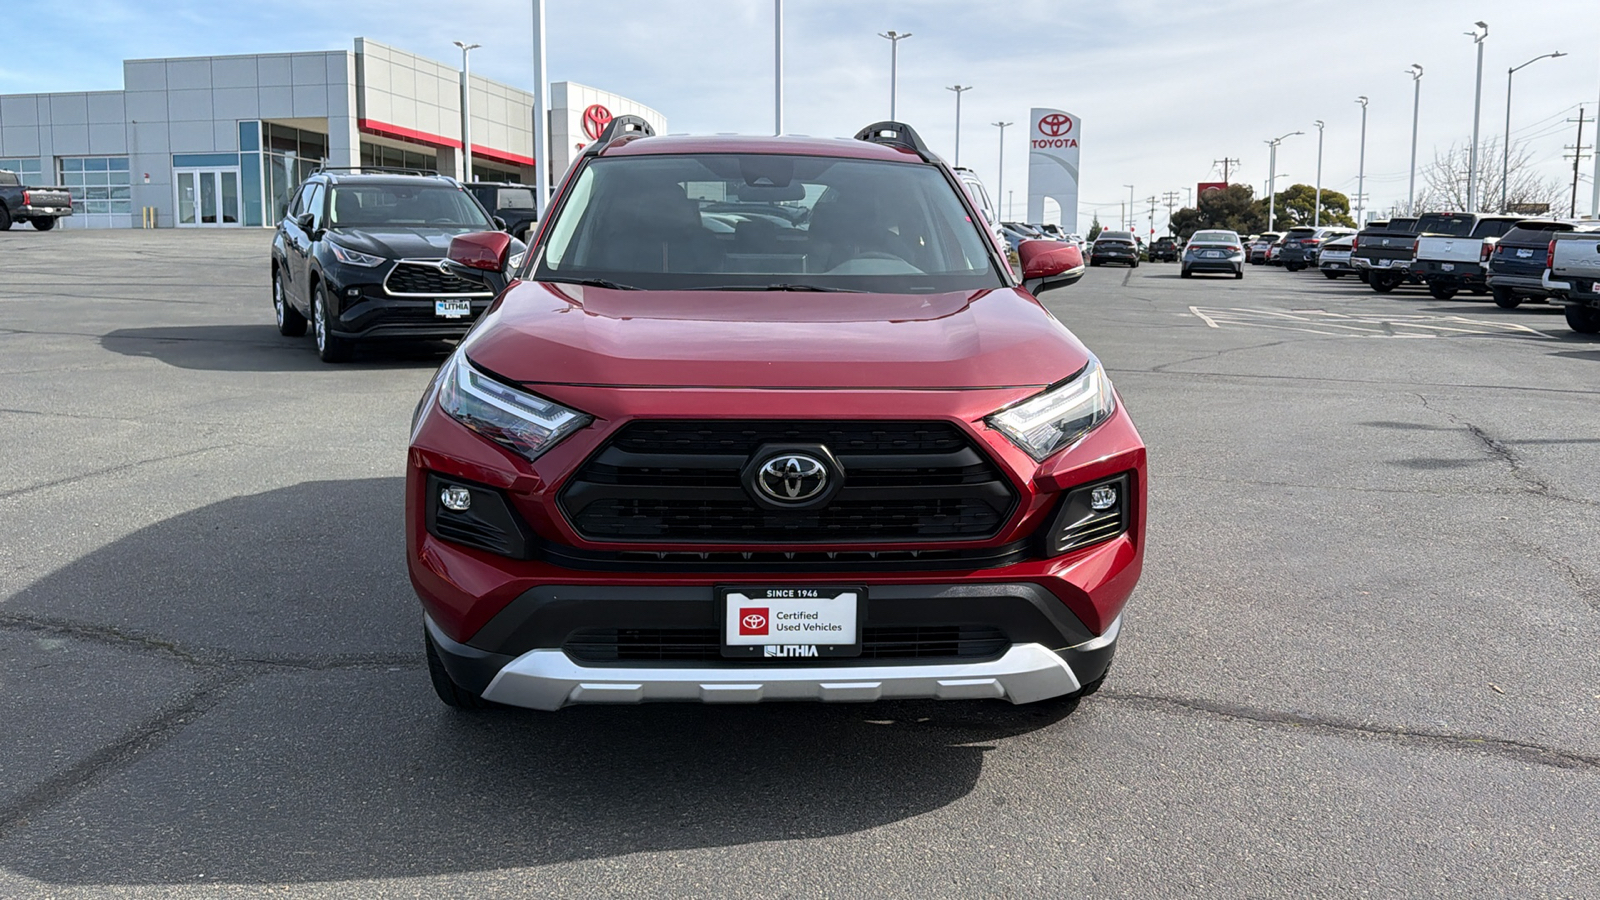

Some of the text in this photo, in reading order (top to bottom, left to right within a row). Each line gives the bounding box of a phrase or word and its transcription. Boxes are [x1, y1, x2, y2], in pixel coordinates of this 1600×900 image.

[1031, 138, 1078, 149] TOYOTA
[766, 590, 818, 598] SINCE 1946
[776, 611, 819, 620] Certified
[776, 623, 842, 632] Used Vehicles
[776, 645, 819, 657] LITHIA
